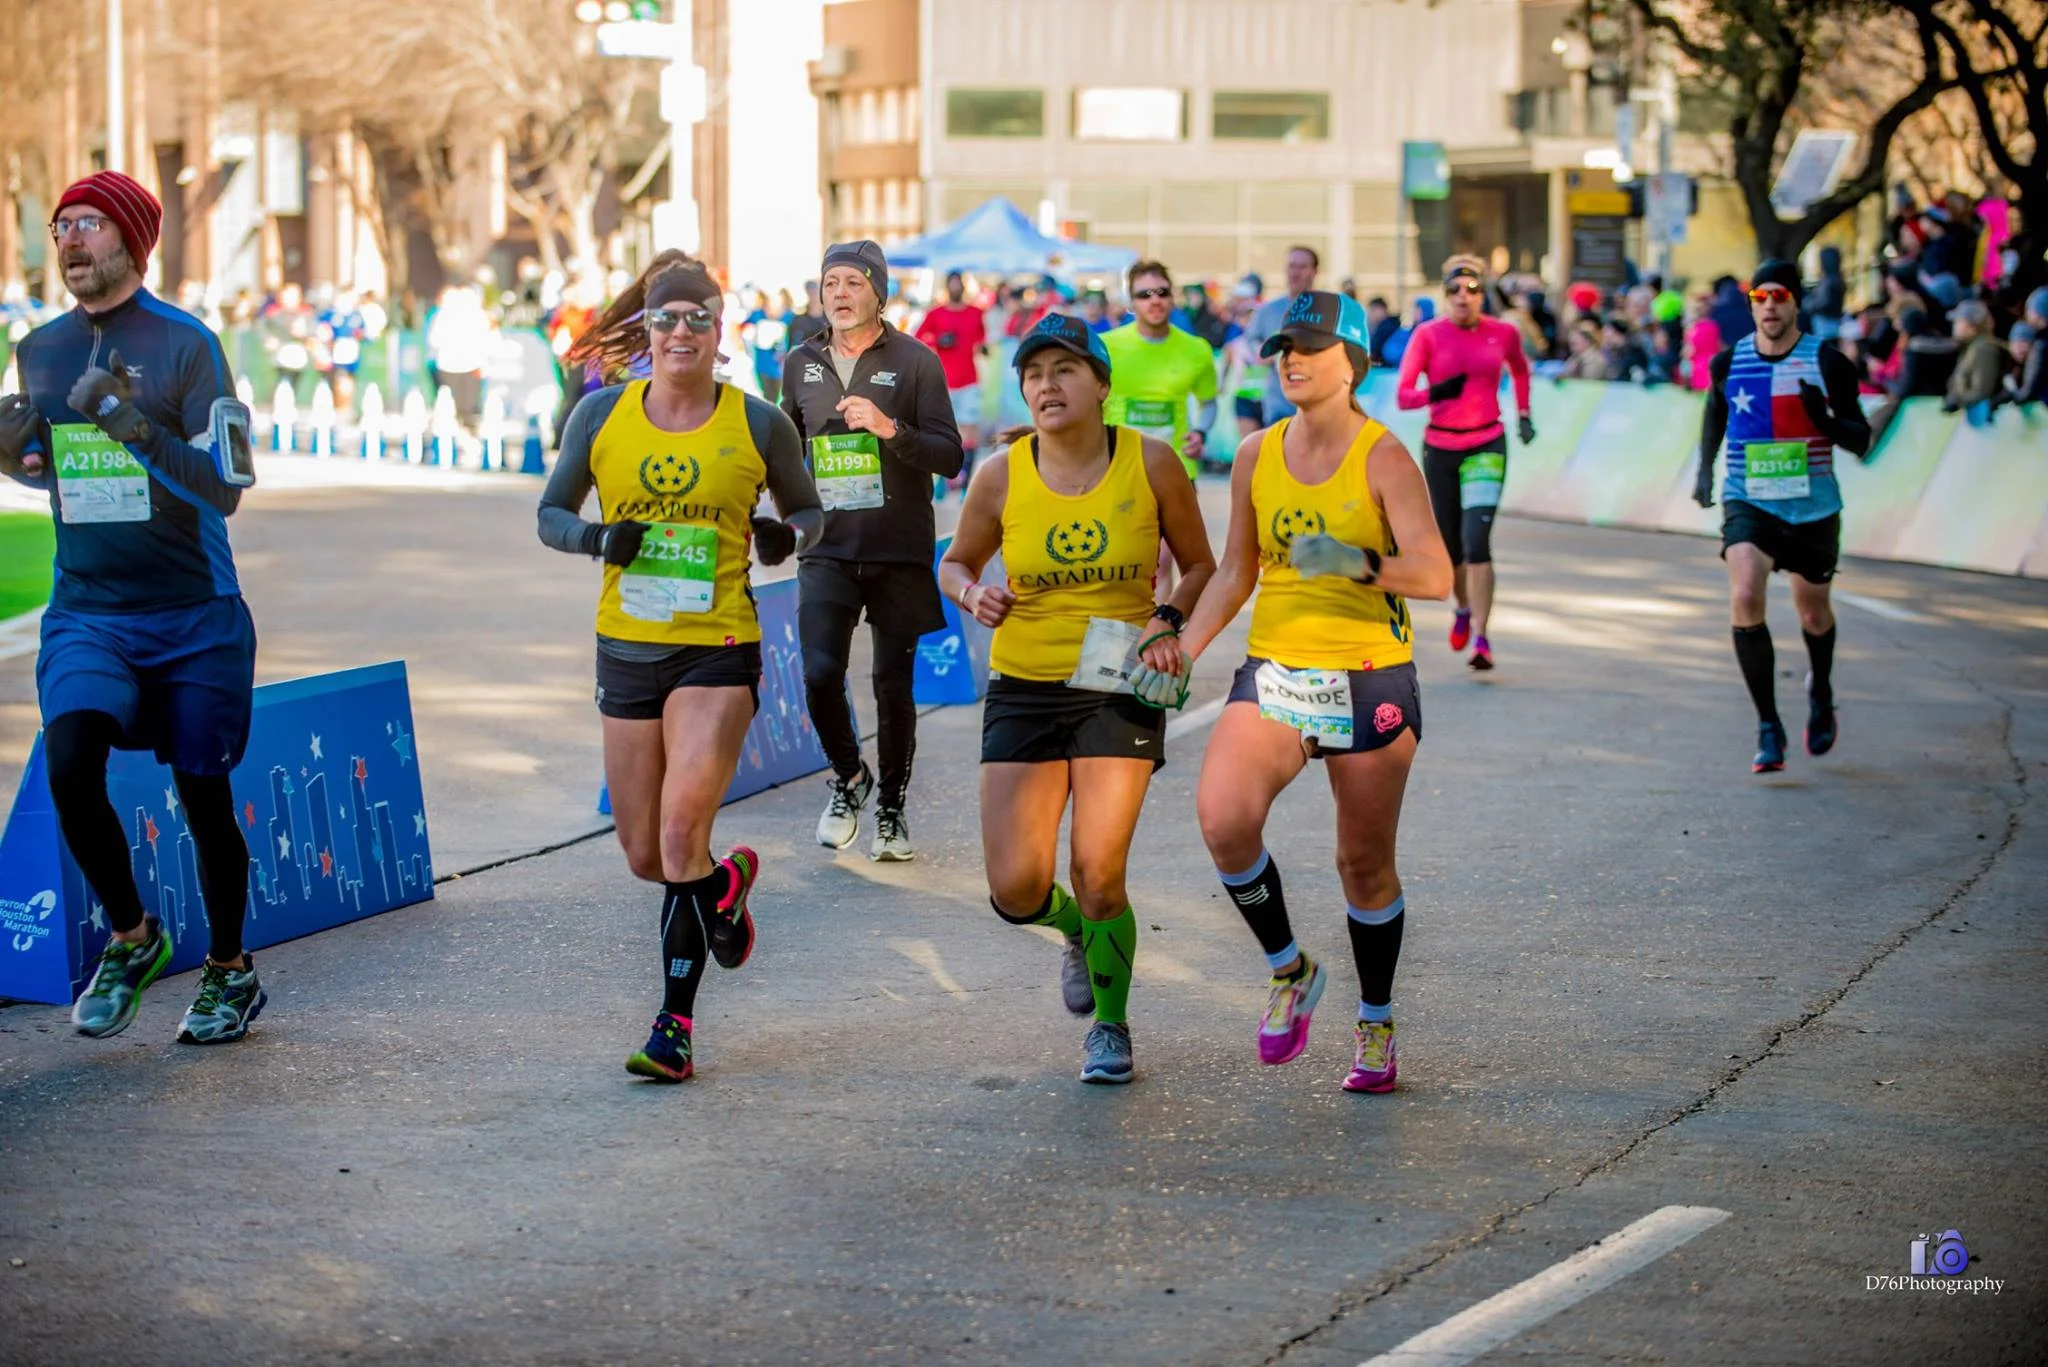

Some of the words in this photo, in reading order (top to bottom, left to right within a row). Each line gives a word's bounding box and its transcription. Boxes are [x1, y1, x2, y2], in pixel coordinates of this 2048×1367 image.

[817, 453, 872, 472] A21991
[638, 540, 707, 564] 22345
[1019, 563, 1143, 587] CATAPULT
[3, 919, 49, 936] Marathon
